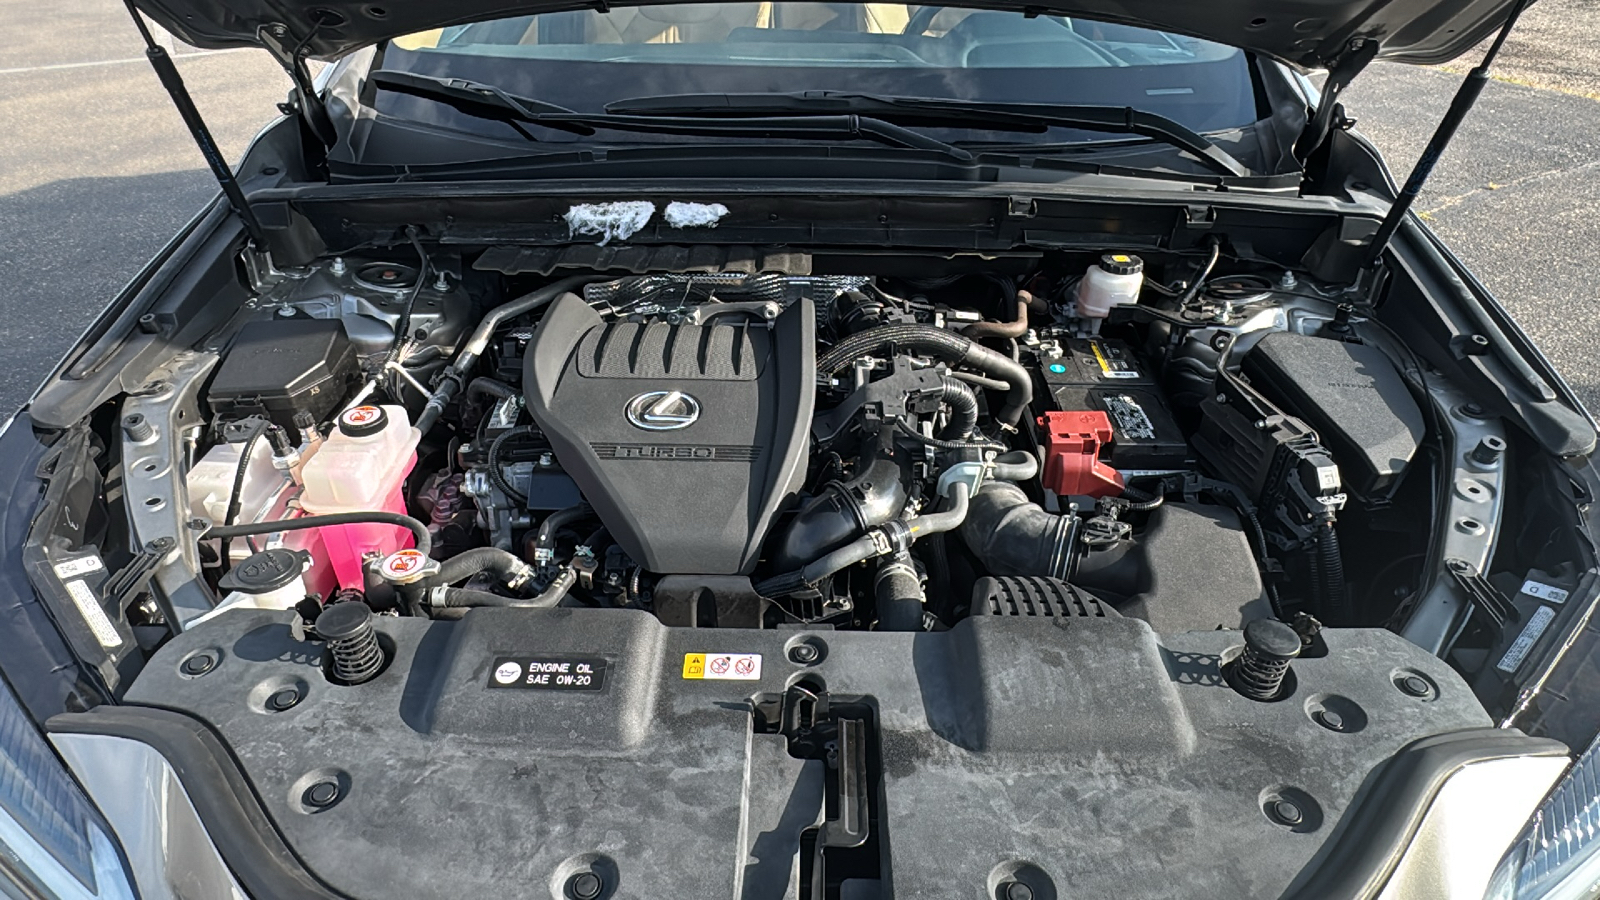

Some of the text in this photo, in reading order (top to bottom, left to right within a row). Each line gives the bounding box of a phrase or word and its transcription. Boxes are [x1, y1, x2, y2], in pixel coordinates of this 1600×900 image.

[615, 446, 714, 459] TURBO
[528, 663, 594, 674] ENGINE OIL
[526, 674, 591, 686] SAE 0W-20
